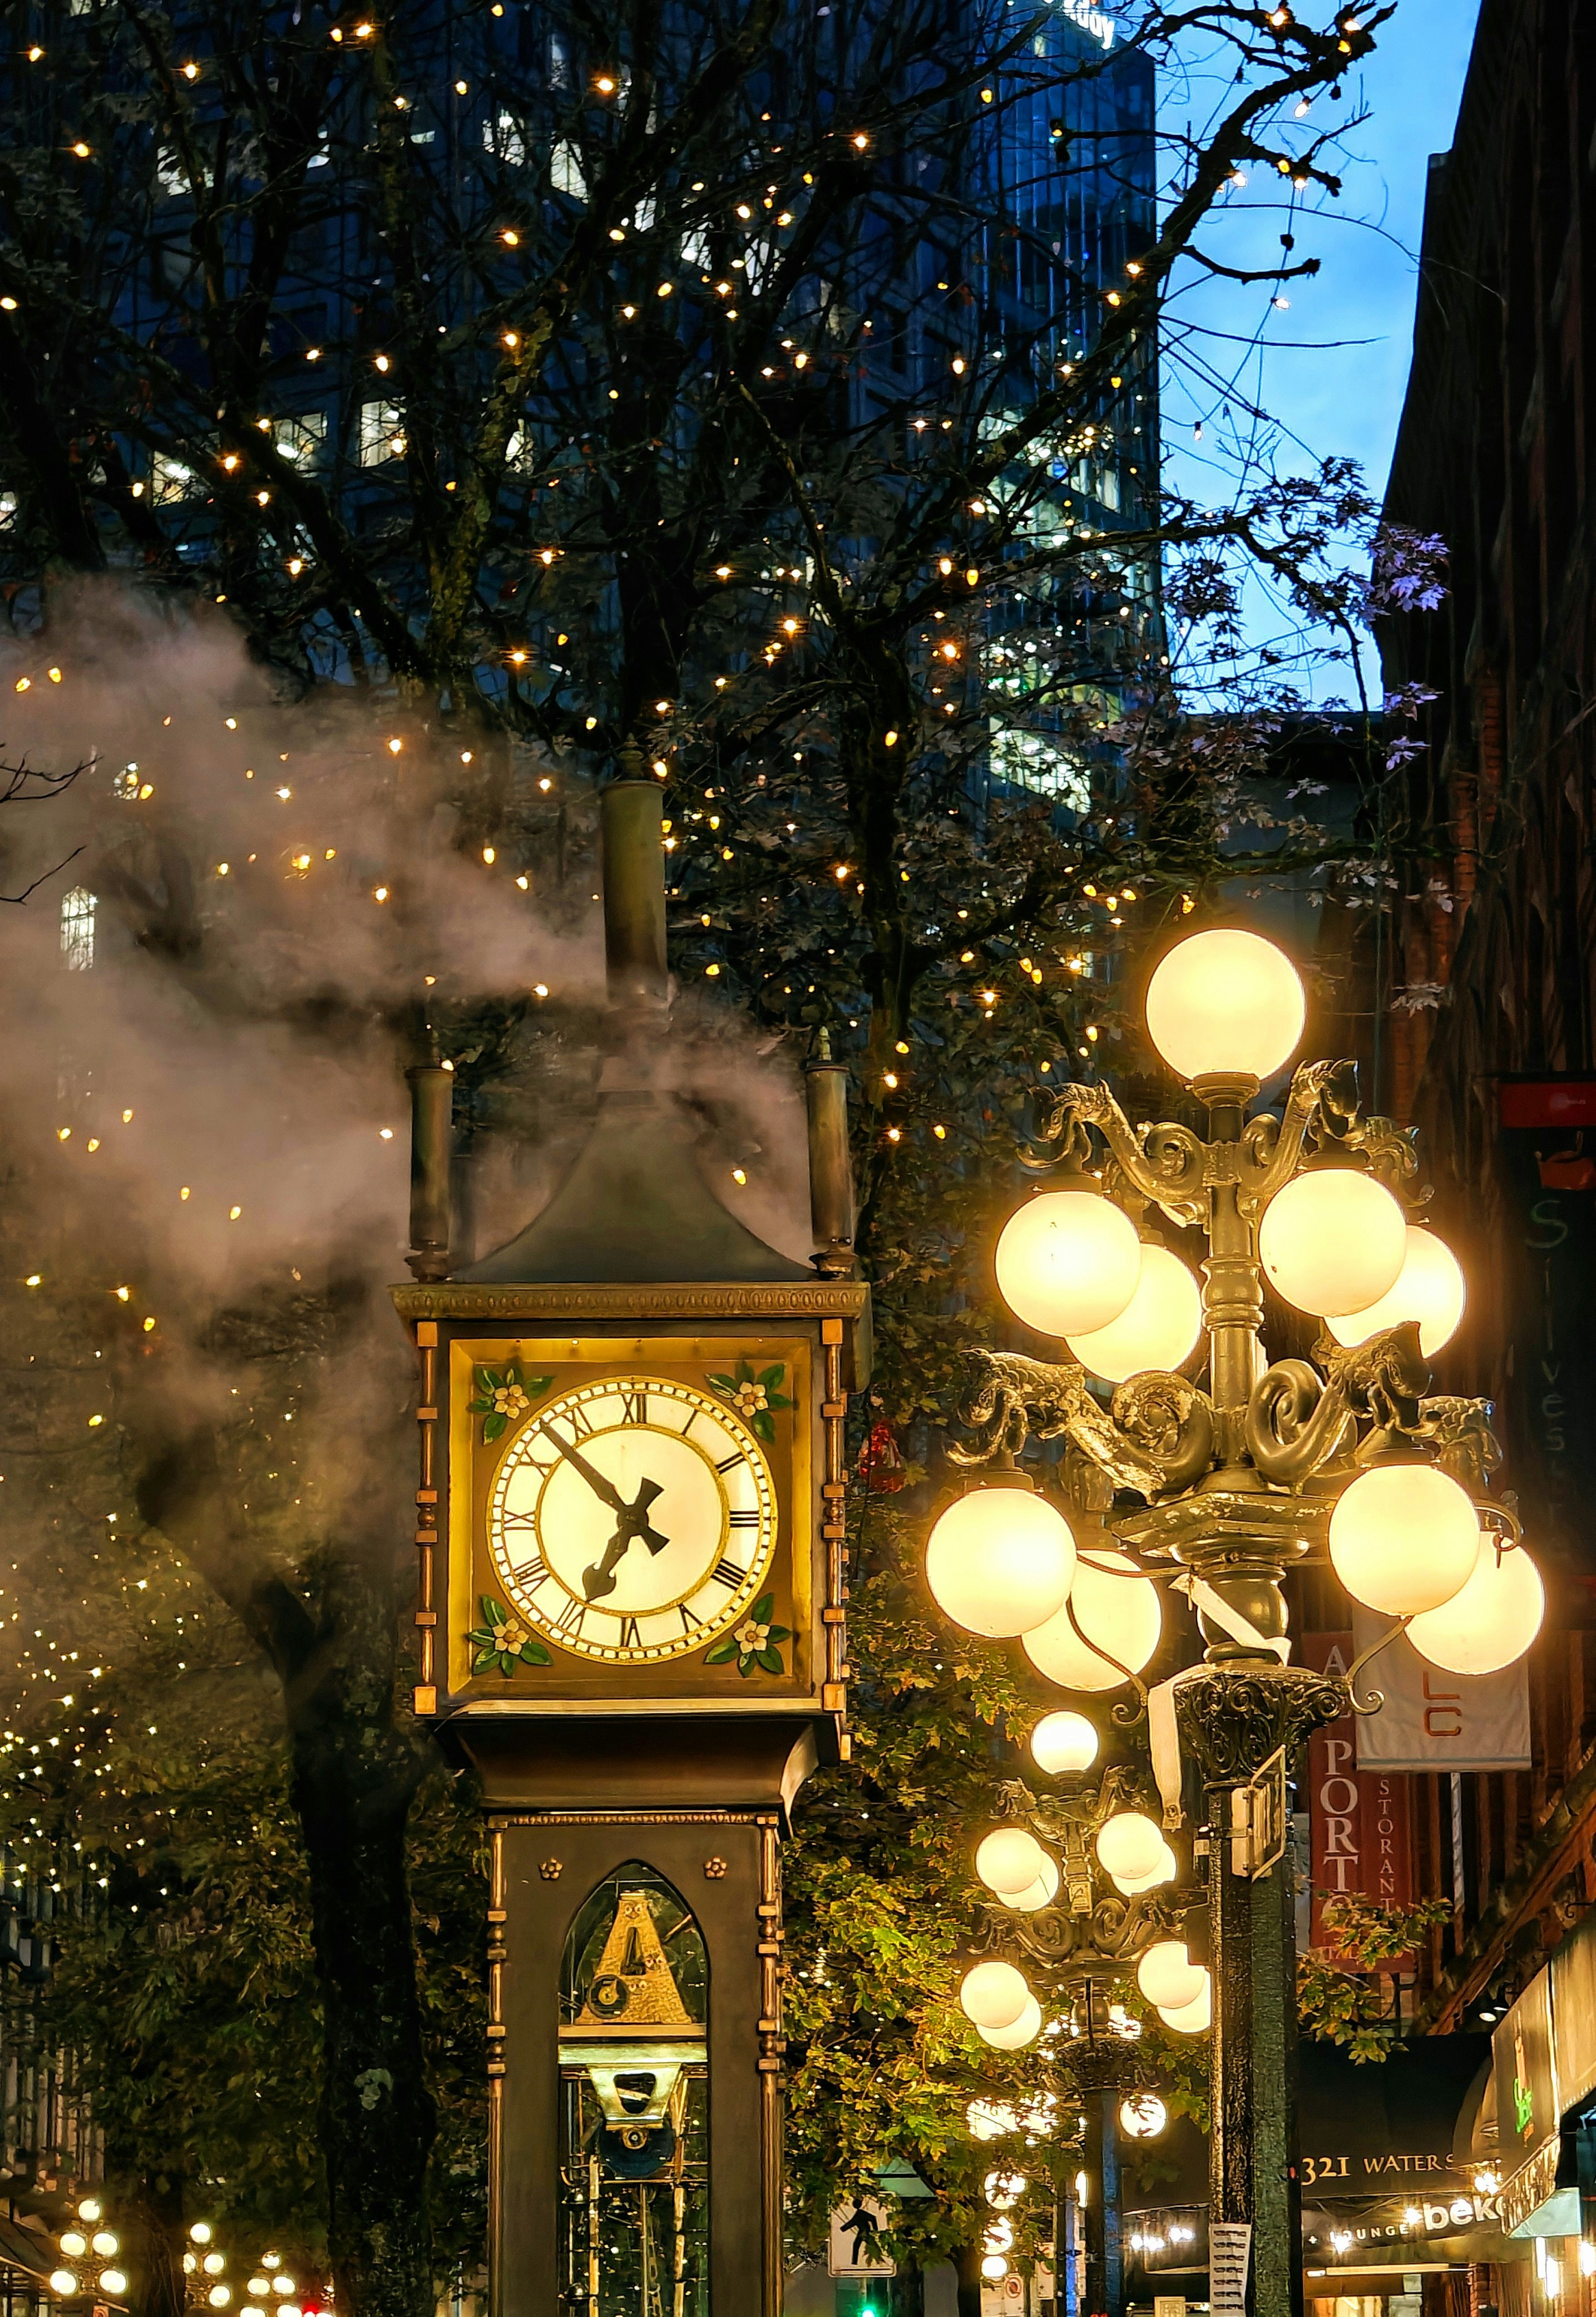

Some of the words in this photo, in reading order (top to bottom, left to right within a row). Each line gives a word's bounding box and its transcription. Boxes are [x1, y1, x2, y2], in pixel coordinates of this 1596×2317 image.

[562, 1406, 594, 1441] XI
[621, 1393, 648, 1424] XII
[518, 1449, 555, 1478] X
[715, 1451, 747, 1475] II
[502, 1509, 537, 1531] IX
[729, 1510, 760, 1529] III
[556, 1597, 587, 1636] VII
[676, 1603, 704, 1633] V
[619, 1616, 641, 1648] VI
[1377, 1779, 1395, 1914] STORANT
[1301, 2157, 1351, 2186] 321
[1363, 2154, 1442, 2174] WATER
[1445, 2153, 1455, 2170] S
[1329, 2224, 1410, 2245] LOUNGE
